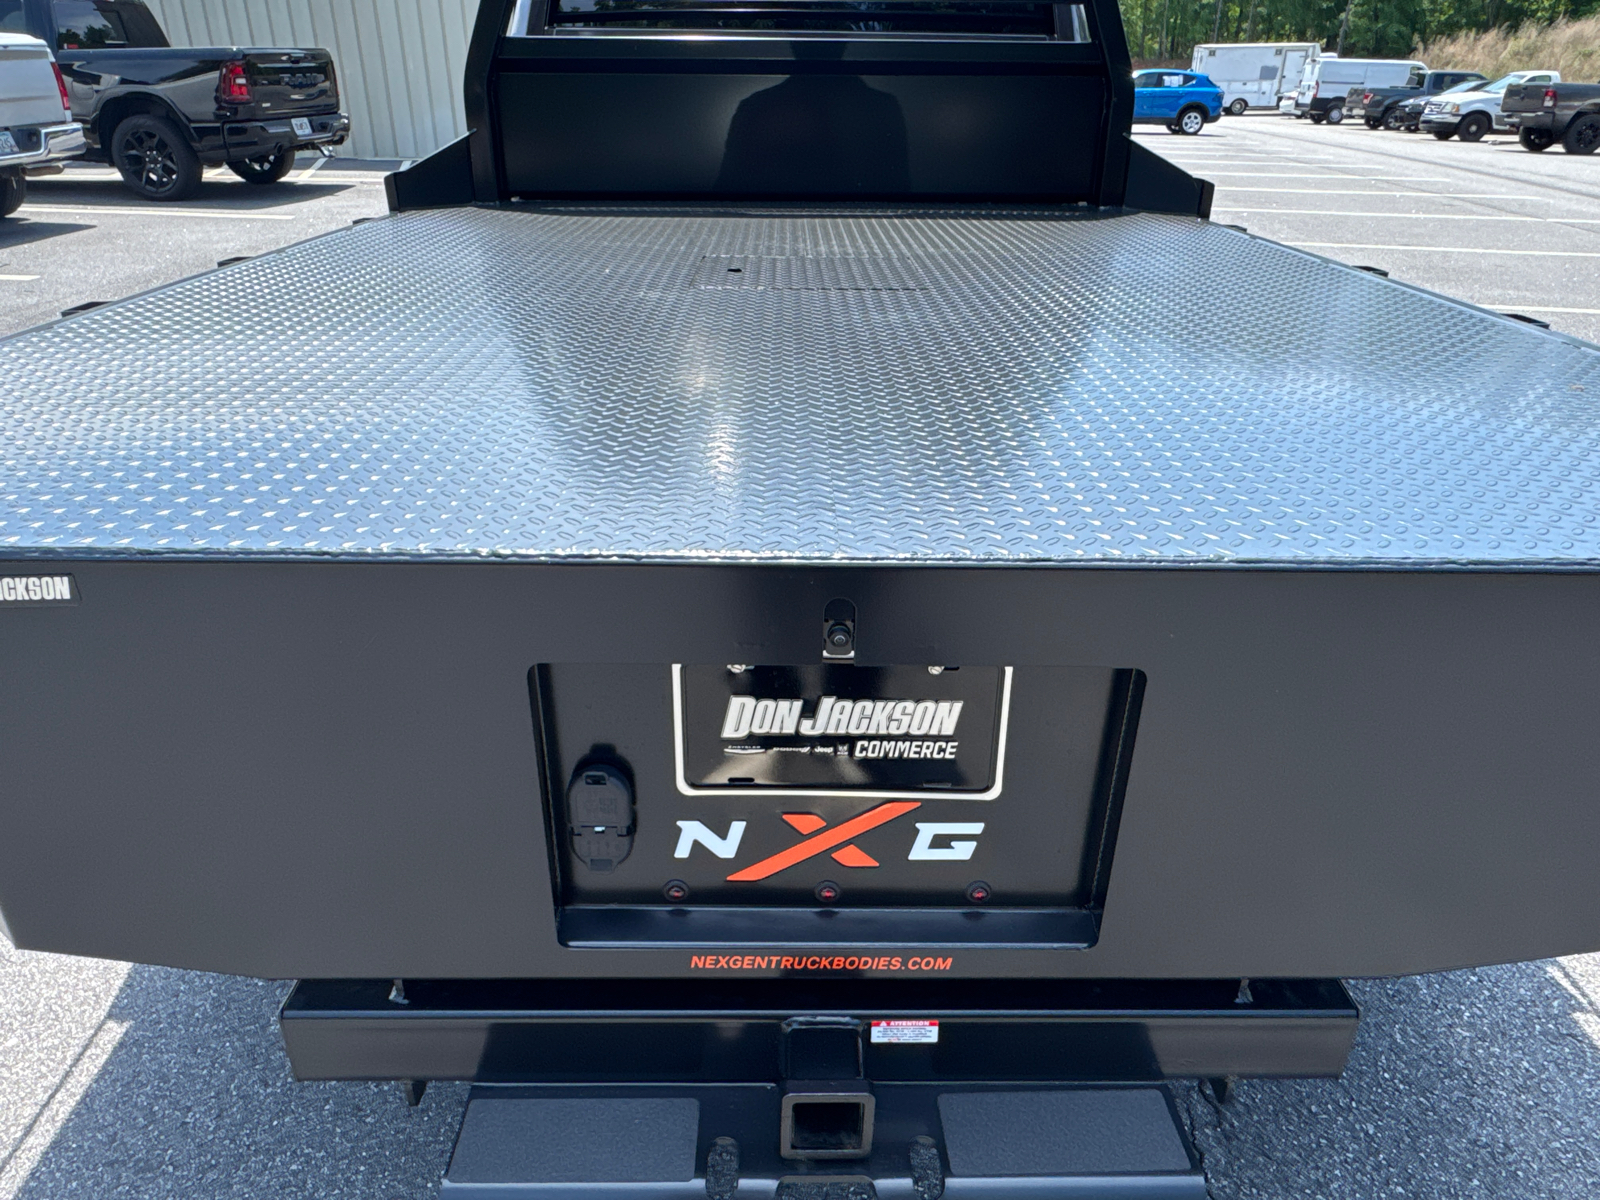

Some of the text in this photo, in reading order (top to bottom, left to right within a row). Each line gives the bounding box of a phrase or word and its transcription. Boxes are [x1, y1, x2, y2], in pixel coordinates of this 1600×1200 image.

[0, 576, 71, 601] CKSON
[721, 695, 964, 739] DON JACKSON
[854, 740, 959, 759] COMMERCE
[690, 955, 953, 970] NEXGENTRUCKBODIES.COM
